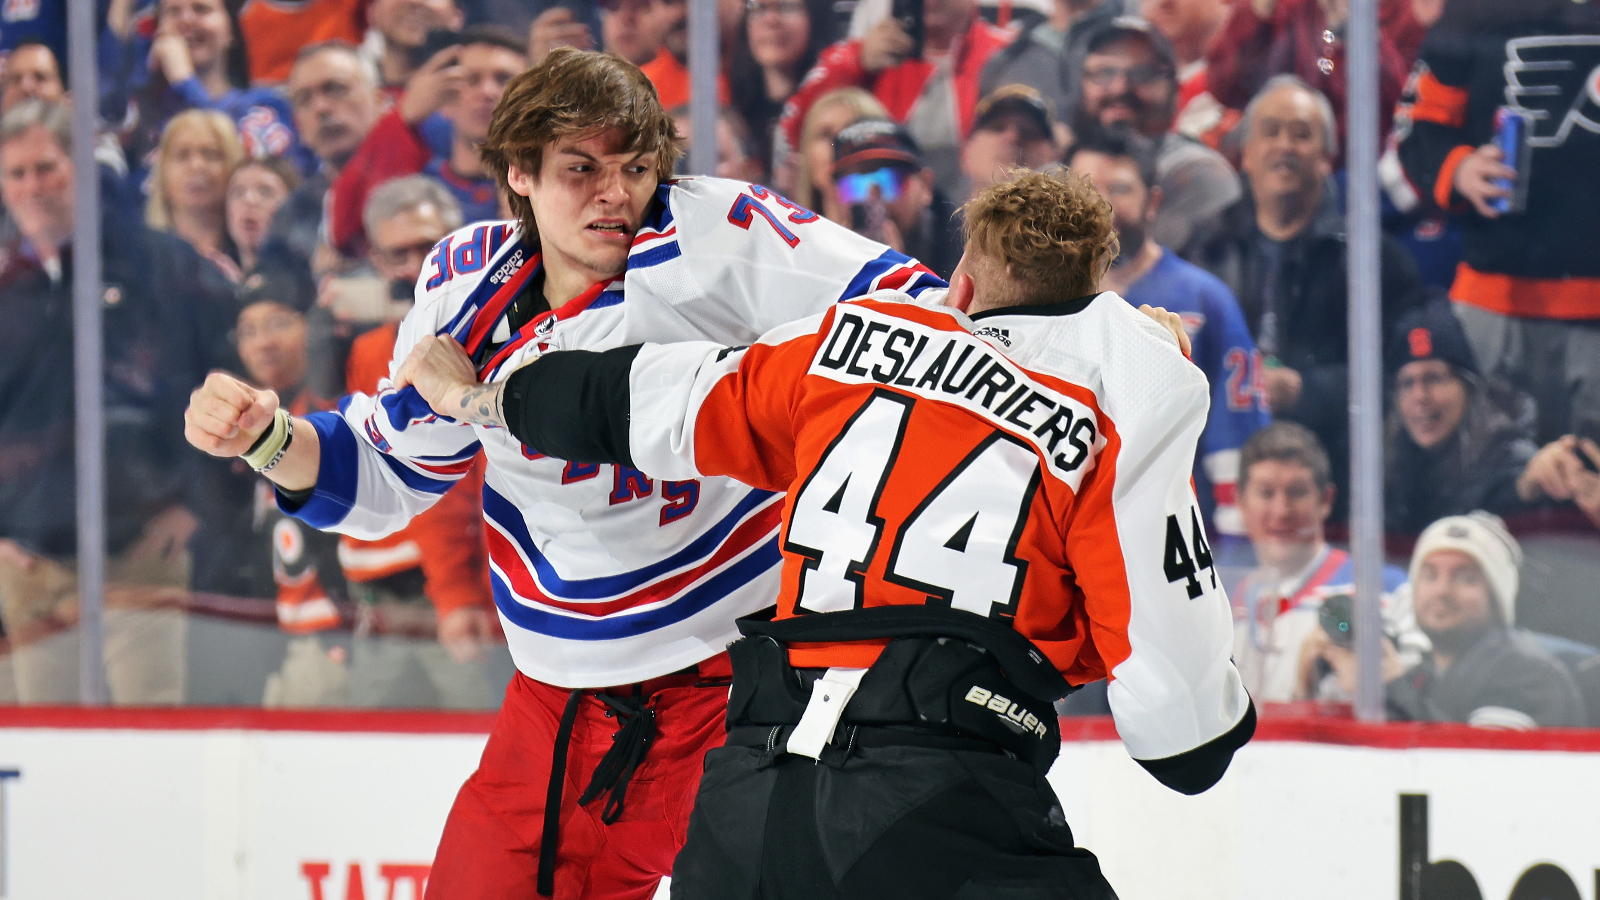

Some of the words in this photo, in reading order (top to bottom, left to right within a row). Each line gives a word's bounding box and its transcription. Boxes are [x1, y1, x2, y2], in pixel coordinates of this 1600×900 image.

[489, 249, 524, 285] adidas
[819, 312, 1096, 473] DESLAURIERS
[783, 386, 1031, 620] 44
[1163, 505, 1217, 601] 44
